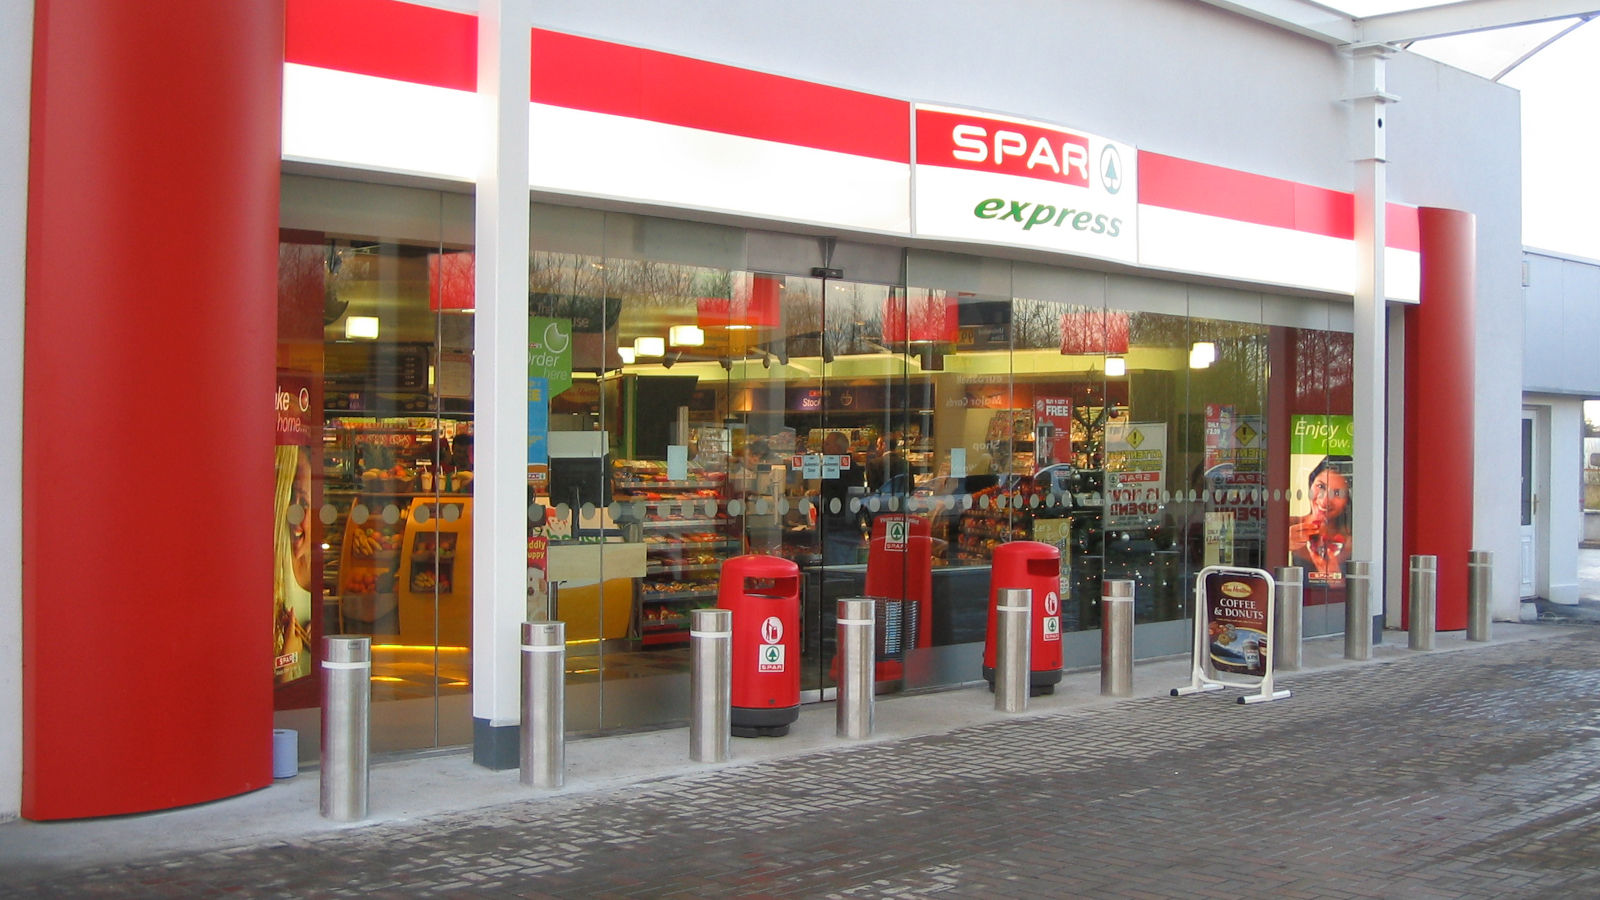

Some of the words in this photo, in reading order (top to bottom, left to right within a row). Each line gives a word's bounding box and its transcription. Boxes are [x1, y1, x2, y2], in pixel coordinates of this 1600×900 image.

[952, 124, 1088, 180] SPAR
[974, 198, 1123, 237] express
[528, 352, 559, 366] rder
[543, 368, 567, 380] here
[1046, 405, 1069, 416] FREE
[1295, 420, 1339, 440] Enjoy
[528, 540, 546, 551] ddly
[528, 551, 545, 560] uppy
[1220, 599, 1256, 609] COFFEE
[1214, 608, 1222, 616] &
[1225, 608, 1264, 620] DONUTS
